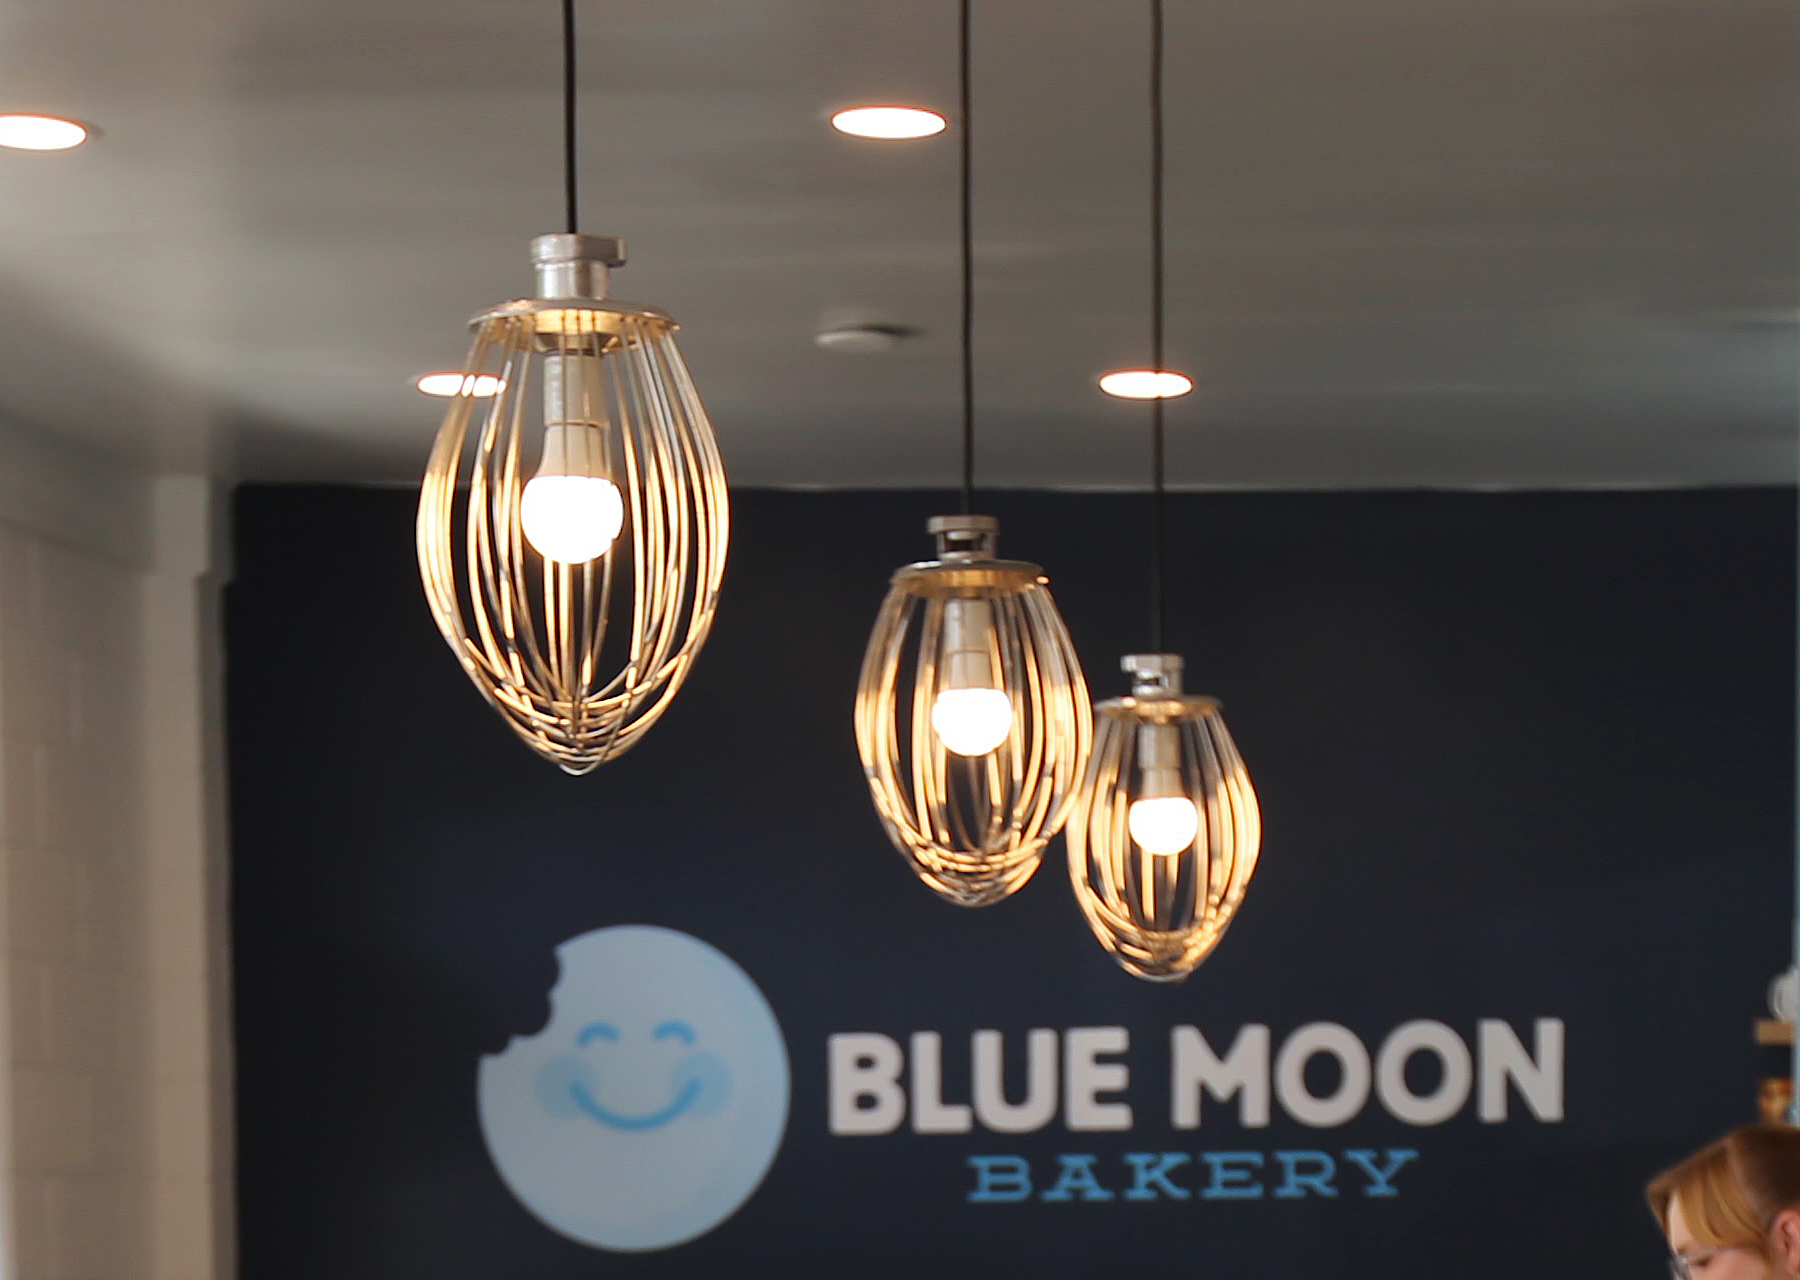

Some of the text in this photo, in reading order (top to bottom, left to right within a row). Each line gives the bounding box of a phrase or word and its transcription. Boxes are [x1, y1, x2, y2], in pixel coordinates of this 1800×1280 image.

[827, 1019, 1566, 1136] BLUE MOON
[967, 1148, 1419, 1203] BAKERY
